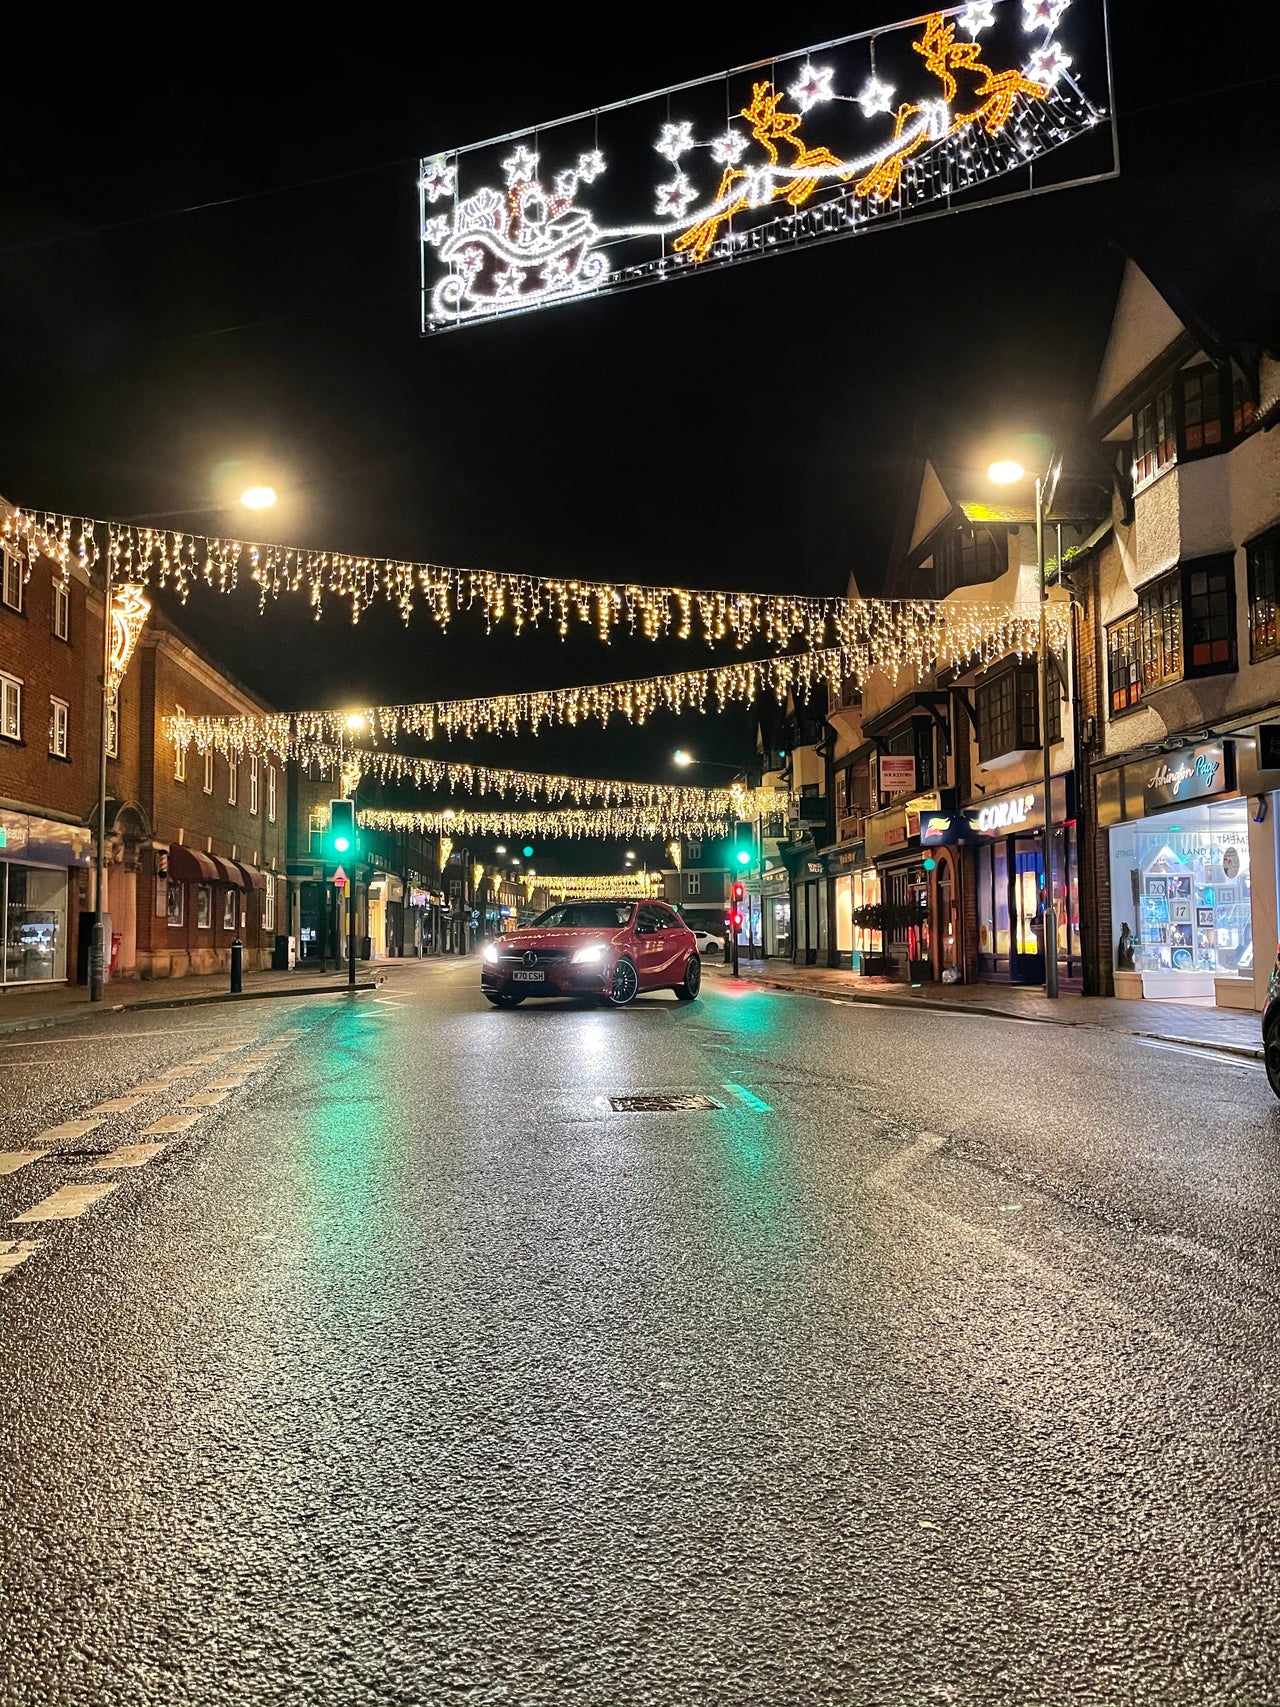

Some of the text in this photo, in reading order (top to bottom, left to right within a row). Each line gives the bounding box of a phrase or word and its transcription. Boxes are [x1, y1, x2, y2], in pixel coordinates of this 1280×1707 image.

[1147, 754, 1219, 795] Ashington Page
[980, 798, 1026, 831] CORAL
[7, 827, 28, 844] eauty
[1182, 848, 1206, 856] LAND
[1150, 883, 1164, 894] 20
[1176, 907, 1186, 917] 17
[528, 972, 544, 980] CSH
